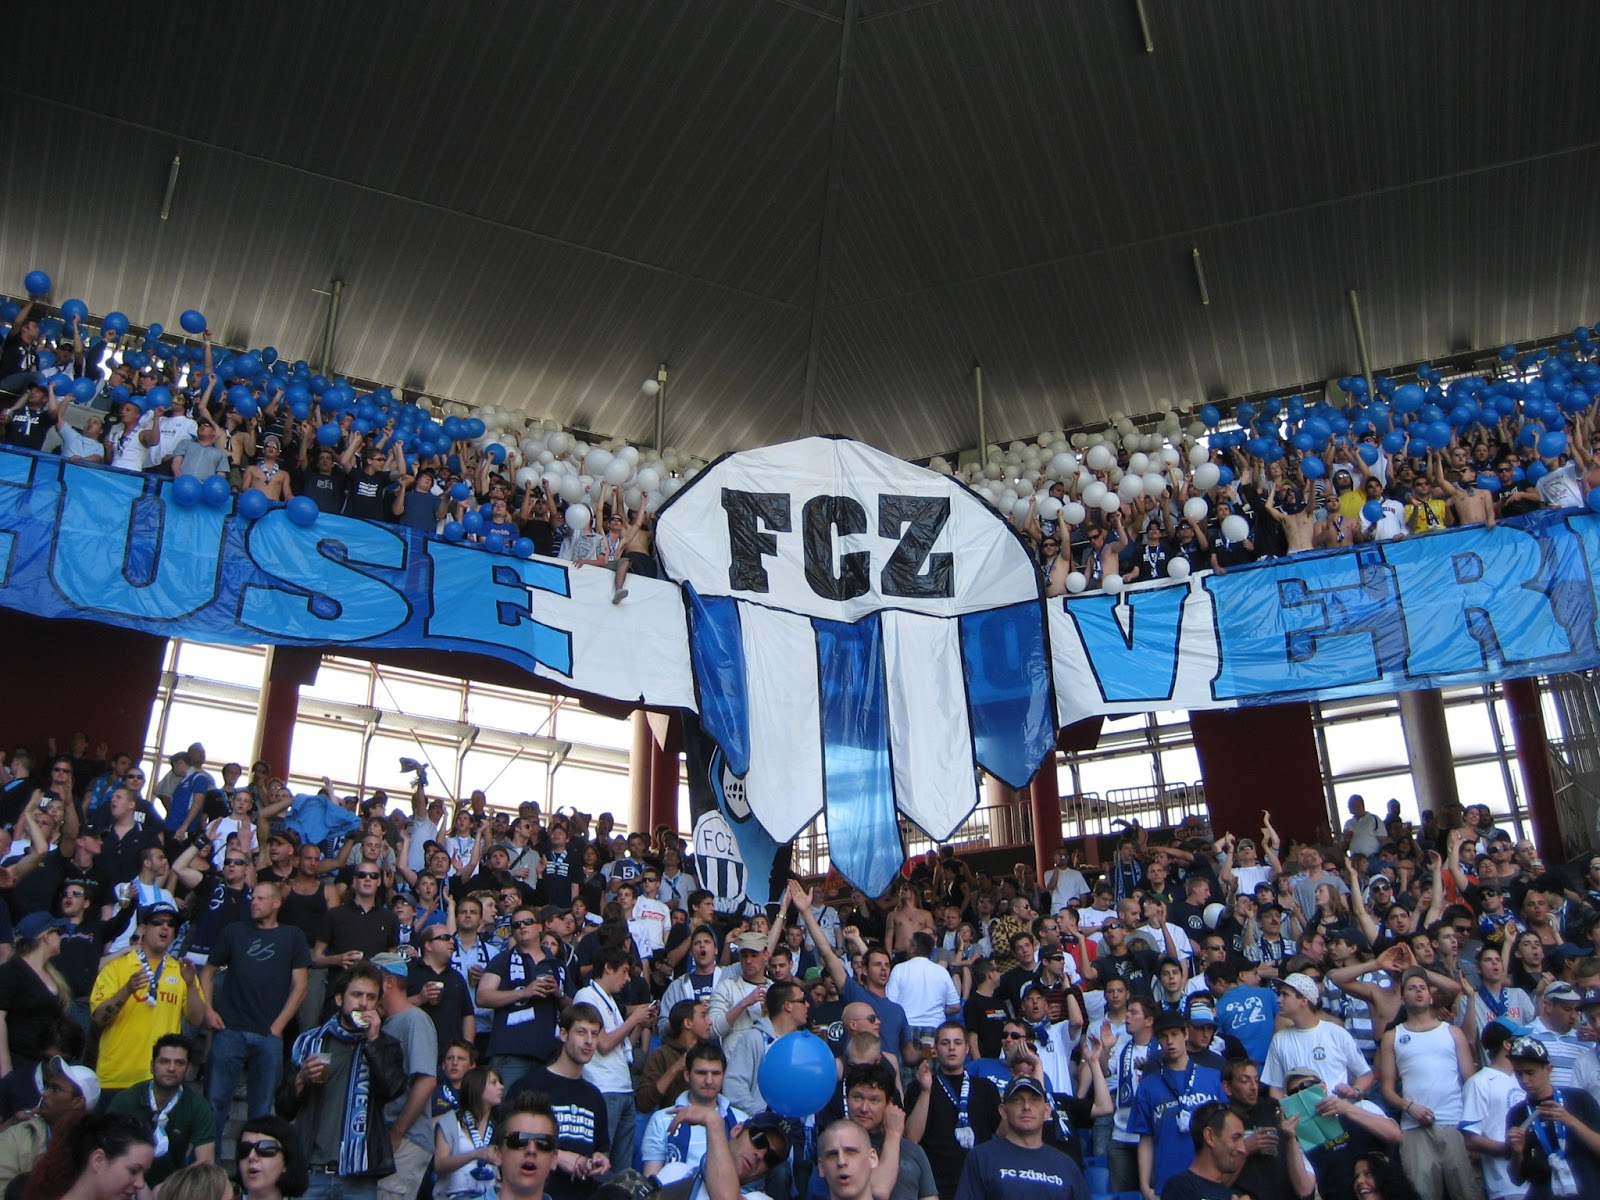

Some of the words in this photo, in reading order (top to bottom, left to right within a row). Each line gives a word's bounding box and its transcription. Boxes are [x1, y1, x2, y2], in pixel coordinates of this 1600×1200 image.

[721, 486, 956, 601] FCZ
[703, 829, 735, 857] FCZ
[624, 867, 635, 879] 5
[159, 991, 178, 1005] TUI
[999, 1168, 1016, 1179] FC
